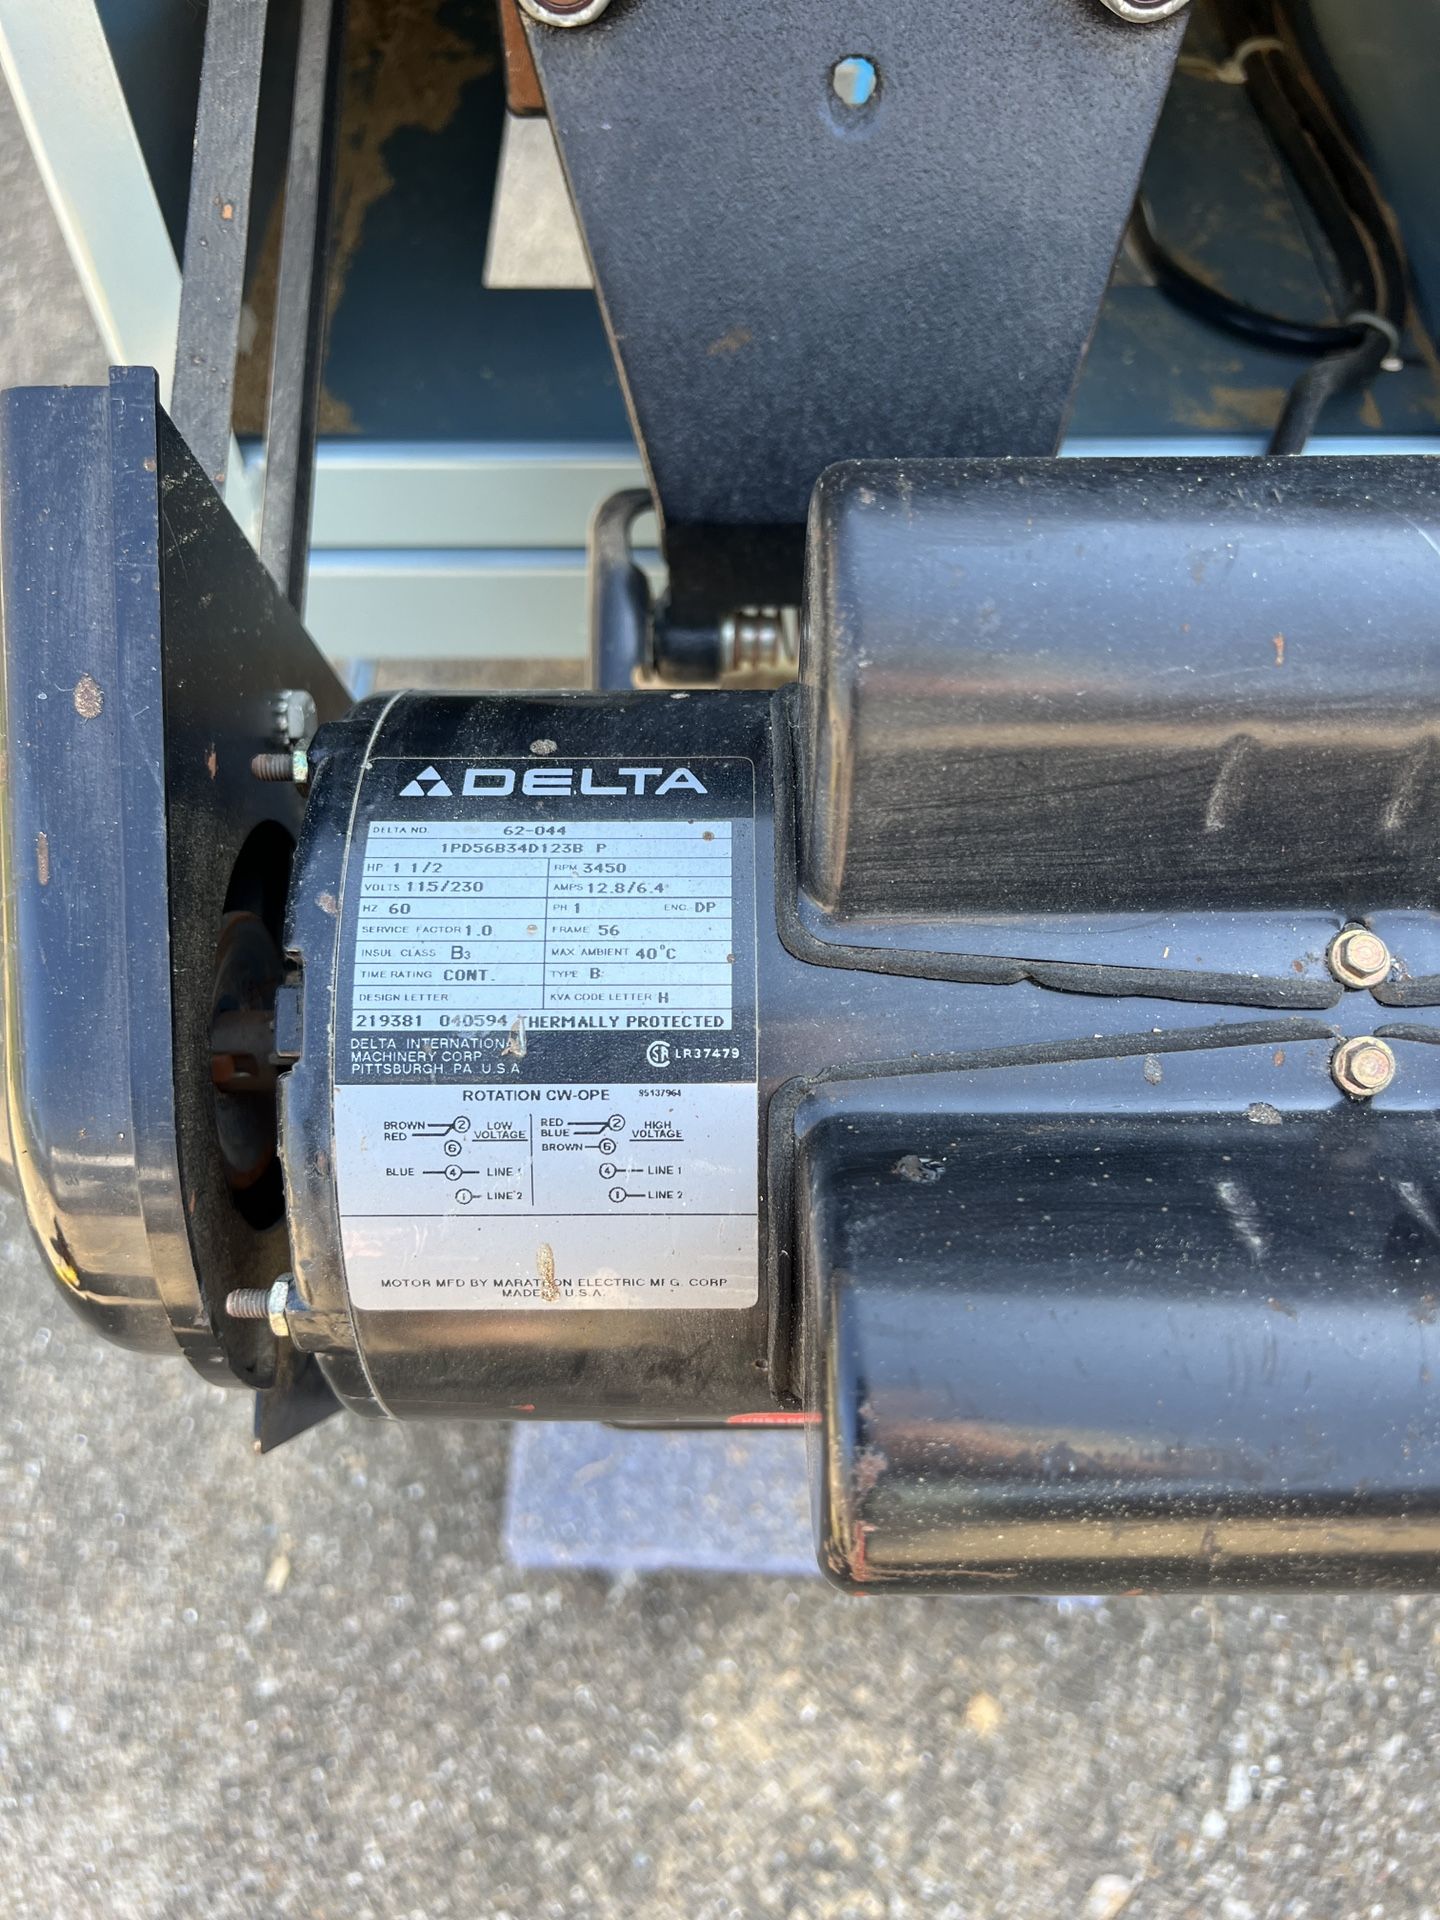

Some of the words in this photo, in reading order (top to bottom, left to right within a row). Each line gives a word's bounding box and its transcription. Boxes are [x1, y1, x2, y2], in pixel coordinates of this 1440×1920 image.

[461, 767, 708, 796] DELTA
[373, 826, 407, 834] DELTA
[503, 826, 567, 836] 62-044
[442, 843, 584, 854] 1PD56B34D123B
[596, 843, 607, 854] P
[367, 863, 384, 872] HP
[394, 863, 400, 873] 1
[412, 861, 443, 873] 1/2
[583, 863, 627, 873] 3450
[365, 883, 400, 892] VOLTS
[407, 880, 484, 893] 115/230
[554, 883, 583, 891] AMPS
[588, 882, 664, 894] 12.8/6.4
[363, 904, 378, 912] HZ
[389, 903, 411, 915] 60
[574, 902, 580, 914] 1
[695, 901, 716, 913] DP
[362, 925, 409, 934] SERVICE
[416, 925, 462, 934] FACTOR
[465, 924, 492, 937] 1.0
[598, 924, 620, 936] 56
[400, 949, 436, 957] CLASS
[552, 948, 575, 956] MAX
[581, 948, 629, 956] AMBIENT
[635, 944, 676, 960] 40°C
[361, 970, 385, 979] TIME
[391, 970, 432, 979] RATING
[443, 969, 495, 982] CONT.
[551, 970, 578, 978] TYPE
[590, 967, 601, 979] B
[359, 993, 400, 1001] DESIGN
[405, 993, 448, 1001] LETTER
[551, 993, 571, 1001] KVA
[575, 993, 606, 1001] CODE
[609, 993, 652, 1001] LETTER
[658, 992, 669, 1004] H
[356, 1014, 422, 1027] 219381
[439, 1014, 508, 1027] 040594
[627, 1015, 724, 1028] PROTECTED
[350, 1038, 396, 1049] DELTA
[351, 1051, 437, 1062] MACHINERY
[675, 1048, 740, 1059] LR37479
[463, 1089, 541, 1101] ROTATION
[546, 1089, 610, 1101] CW-OPE
[383, 1121, 426, 1130] BROWN
[457, 1119, 466, 1130] 2
[487, 1121, 513, 1130] LOW
[540, 1118, 564, 1127] RED
[611, 1117, 621, 1128] 2
[644, 1120, 672, 1129] HIGH
[384, 1132, 408, 1141] RED
[474, 1130, 526, 1139] VOLTAGE
[540, 1128, 570, 1137] BLUE
[631, 1129, 683, 1138] VOLTAGE
[541, 1143, 583, 1151] BROWN
[386, 1167, 415, 1176] BLUE
[487, 1167, 513, 1176] LINE
[647, 1165, 674, 1175] LINE
[678, 1166, 682, 1174] 1
[487, 1191, 513, 1200] LINE
[516, 1191, 523, 1200] 2
[647, 1190, 675, 1199] LINE
[678, 1190, 684, 1199] 2
[381, 1278, 432, 1288] MOTOR
[436, 1278, 466, 1288] MFD
[470, 1278, 489, 1288] BY
[578, 1278, 645, 1287] ELECTRIC
[502, 1288, 541, 1297] MADE
